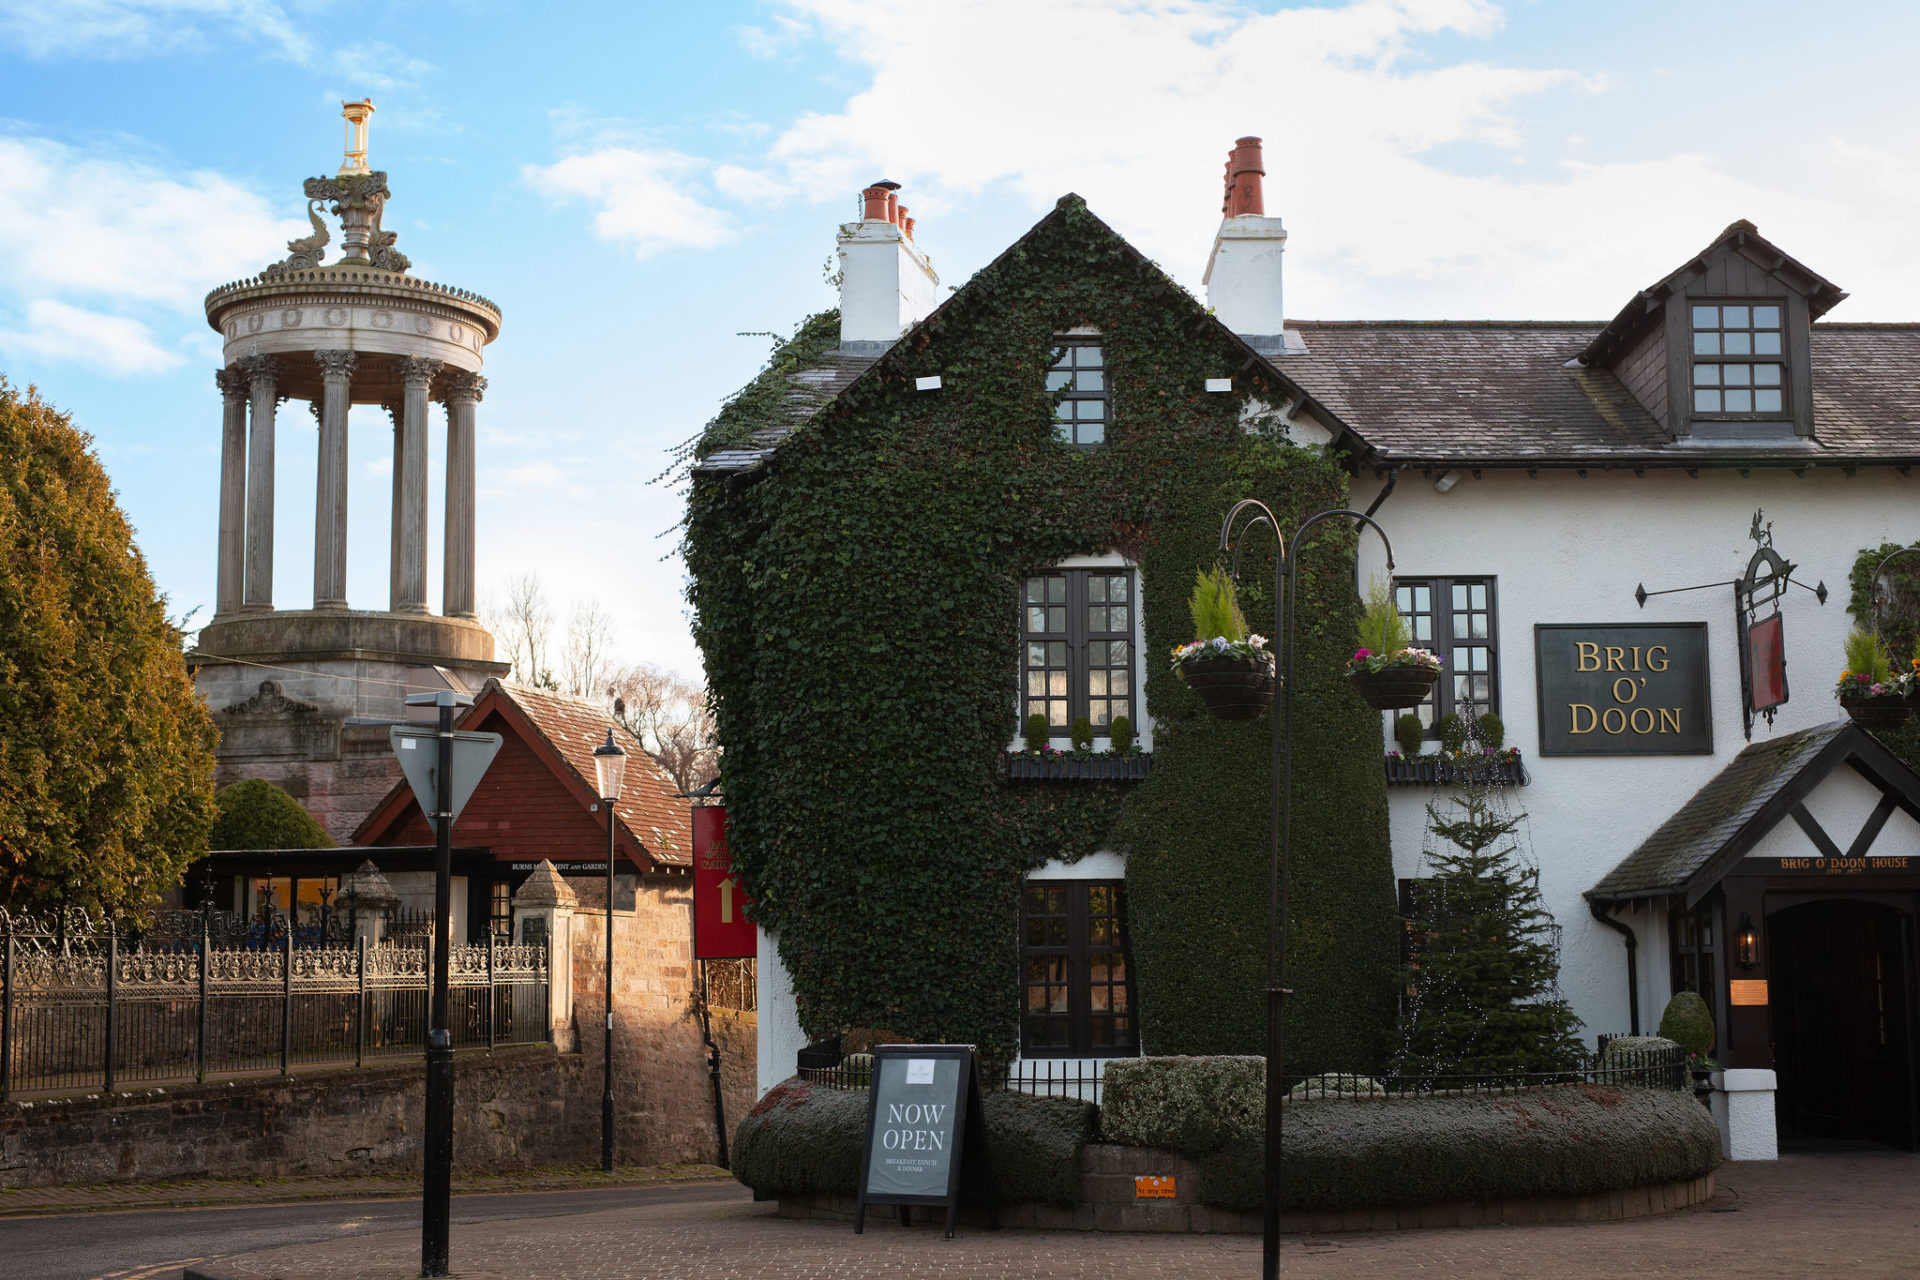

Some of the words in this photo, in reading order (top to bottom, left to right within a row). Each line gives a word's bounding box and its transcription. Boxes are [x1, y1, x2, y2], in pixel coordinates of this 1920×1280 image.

[1575, 641, 1670, 672] BRIG
[1568, 703, 1683, 734] DOON
[1781, 858, 1810, 869] BRIG
[1831, 857, 1866, 868] DOON
[1872, 857, 1909, 868] HOUSE
[887, 1103, 946, 1124] NOW
[883, 1129, 945, 1151] OPEN
